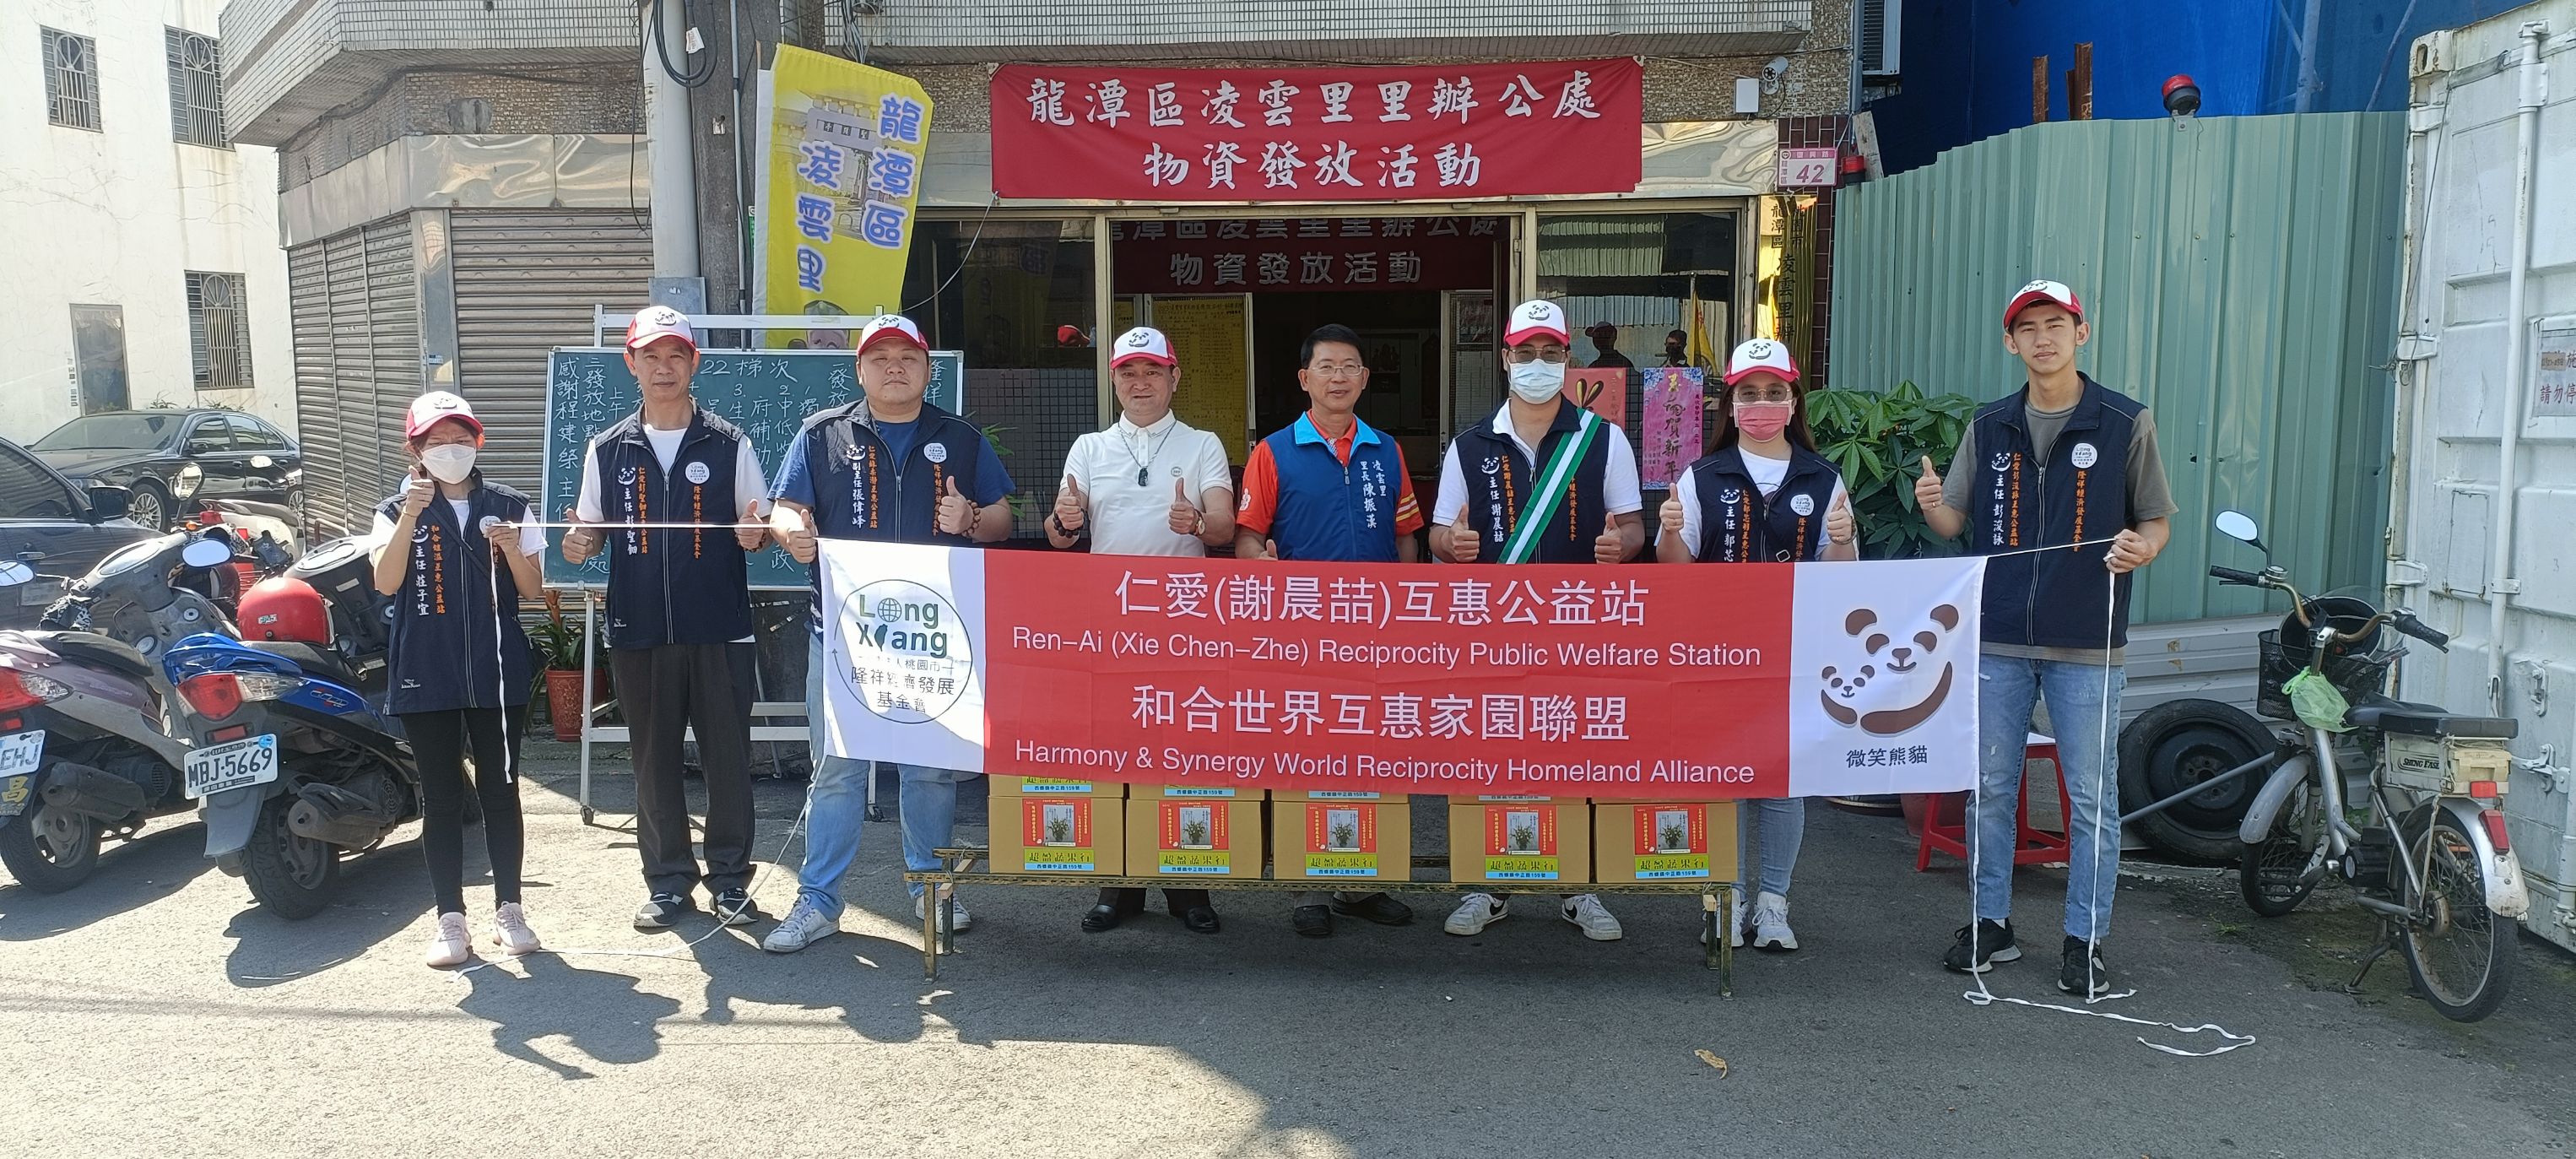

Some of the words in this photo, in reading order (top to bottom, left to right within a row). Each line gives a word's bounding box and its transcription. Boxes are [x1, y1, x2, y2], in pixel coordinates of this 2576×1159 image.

[1026, 71, 1601, 127] 龍潭區凌雲里里辦公處
[863, 95, 923, 247] 龍潭區
[1143, 140, 1481, 190] 物資發放活動
[1796, 165, 1824, 182] 42
[798, 142, 842, 292] 凌雲里
[1170, 251, 1421, 285] 物資發放活動
[1372, 459, 1387, 496] 凌雲里
[1115, 570, 1649, 629] 仁愛(謝晨喆)互惠公益站
[1112, 631, 1160, 660] (Xie
[1318, 640, 1460, 671] Reciprocity
[1470, 642, 1548, 666] Public
[1556, 642, 1659, 667] Welfare
[1668, 642, 1762, 667] Station
[1131, 684, 1630, 743] 和合世界互惠家園聯盟
[1015, 739, 1128, 773] Harmony
[1136, 746, 1154, 770] &
[1162, 747, 1265, 778] Synergy
[1274, 751, 1347, 777] World
[1357, 755, 1499, 786] Reciprocity
[1508, 759, 1641, 783] Homeland
[1650, 760, 1755, 784] Alliance
[1846, 745, 1928, 768] 微笑熊貓
